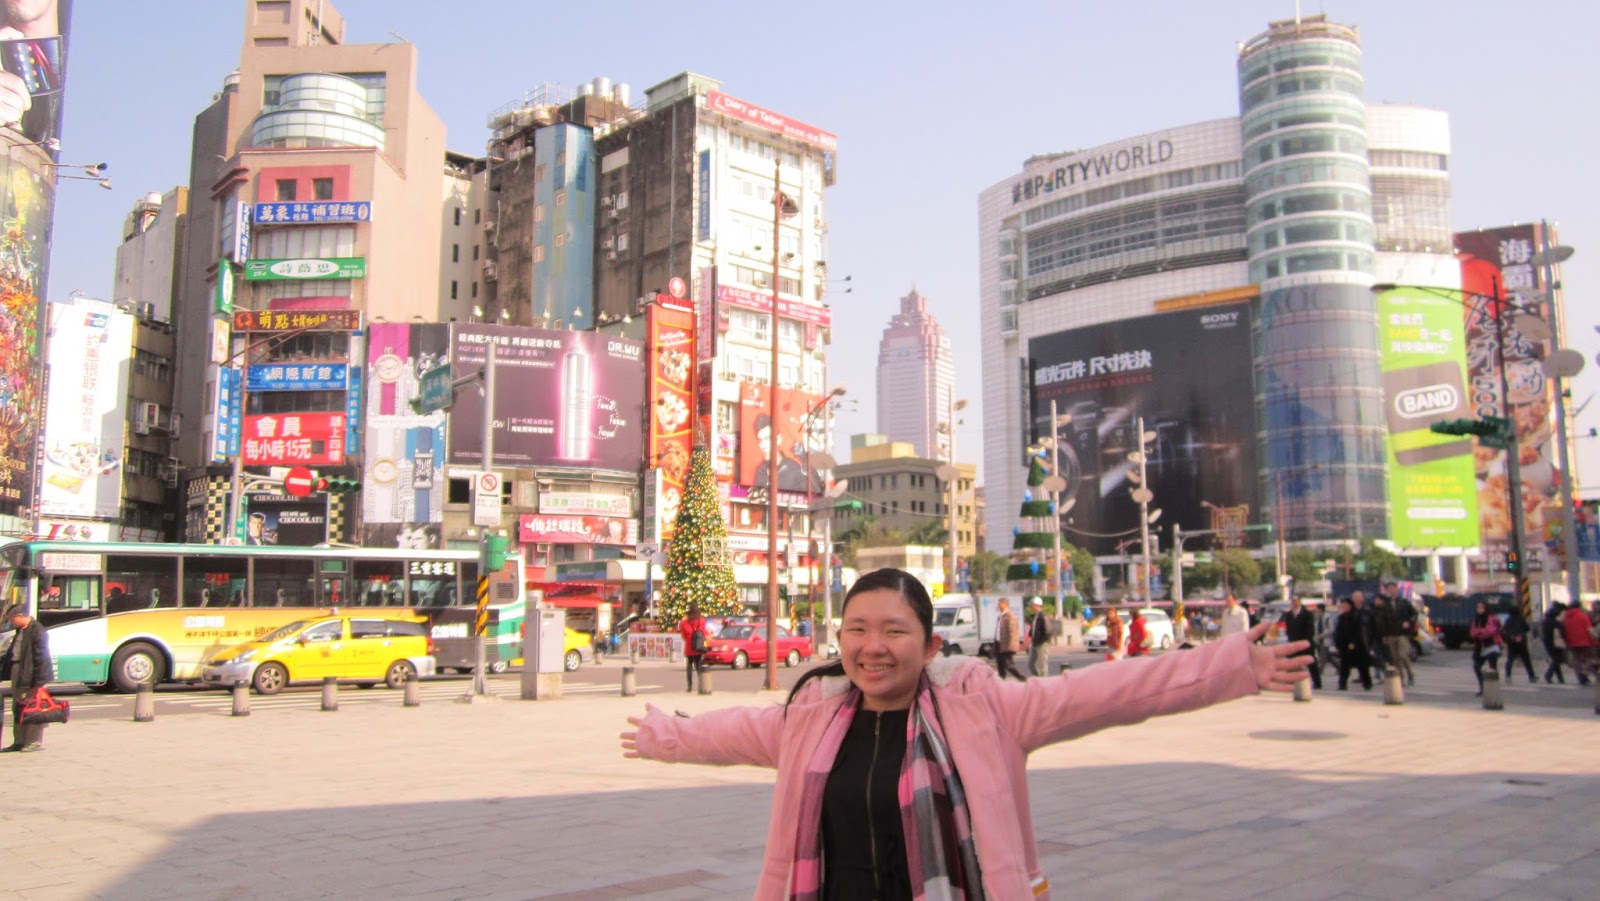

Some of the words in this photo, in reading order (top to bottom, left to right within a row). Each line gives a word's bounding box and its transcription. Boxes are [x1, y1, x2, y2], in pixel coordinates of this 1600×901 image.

[1200, 311, 1239, 323] SONY
[607, 341, 640, 356] DR.WU
[1403, 389, 1452, 413] BAND
[257, 417, 301, 437] 會員
[246, 438, 311, 460] 每小時15元
[526, 518, 590, 535] 仙杜瑞拉
[409, 561, 456, 576] 三重客運
